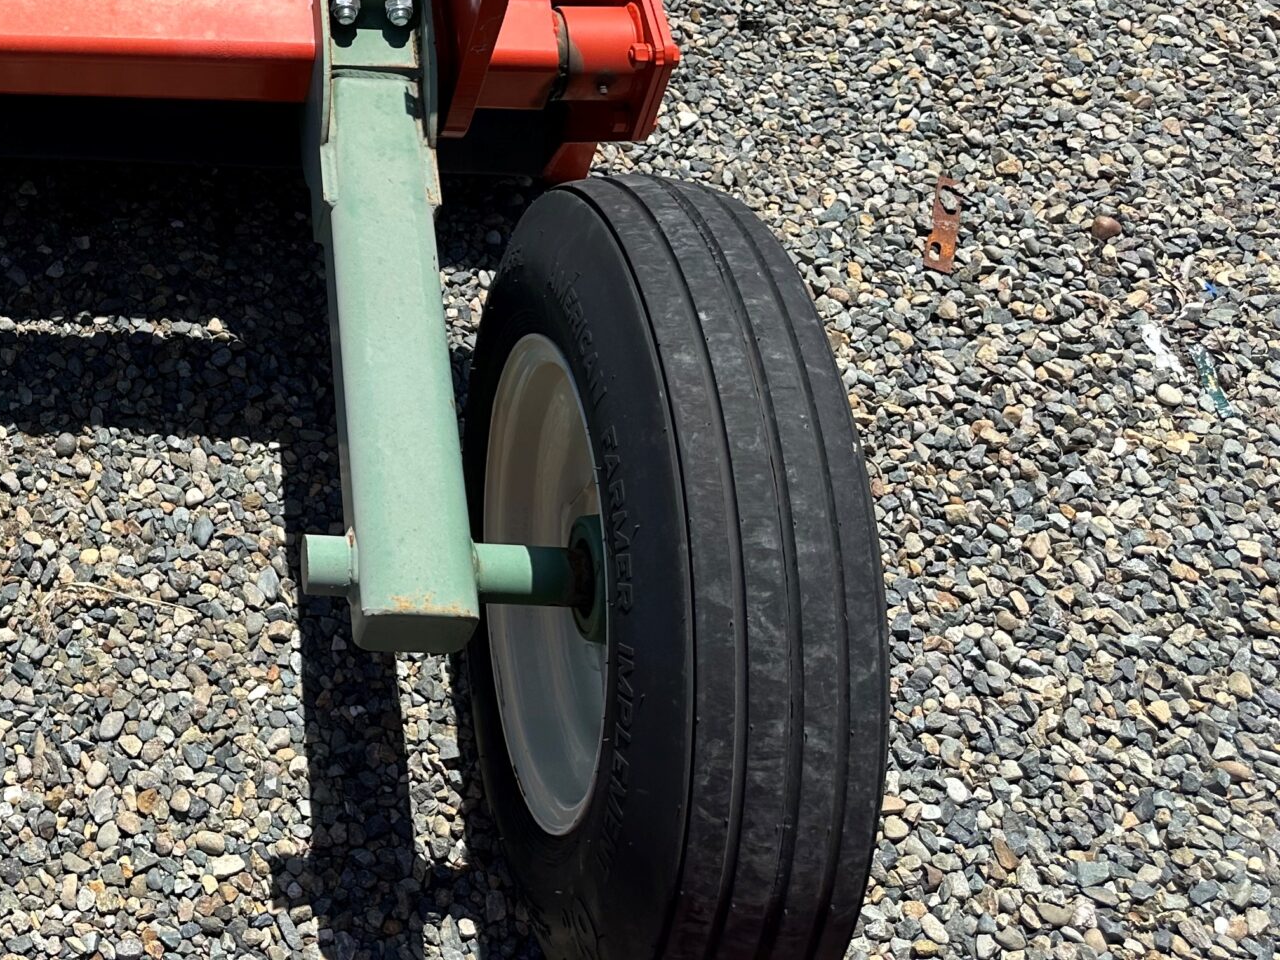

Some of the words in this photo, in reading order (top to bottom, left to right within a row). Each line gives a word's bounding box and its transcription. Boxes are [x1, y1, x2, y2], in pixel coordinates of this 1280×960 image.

[547, 262, 608, 408] AMERICAN
[596, 425, 635, 617] FARMER
[593, 642, 636, 882] IMPLEMENT
